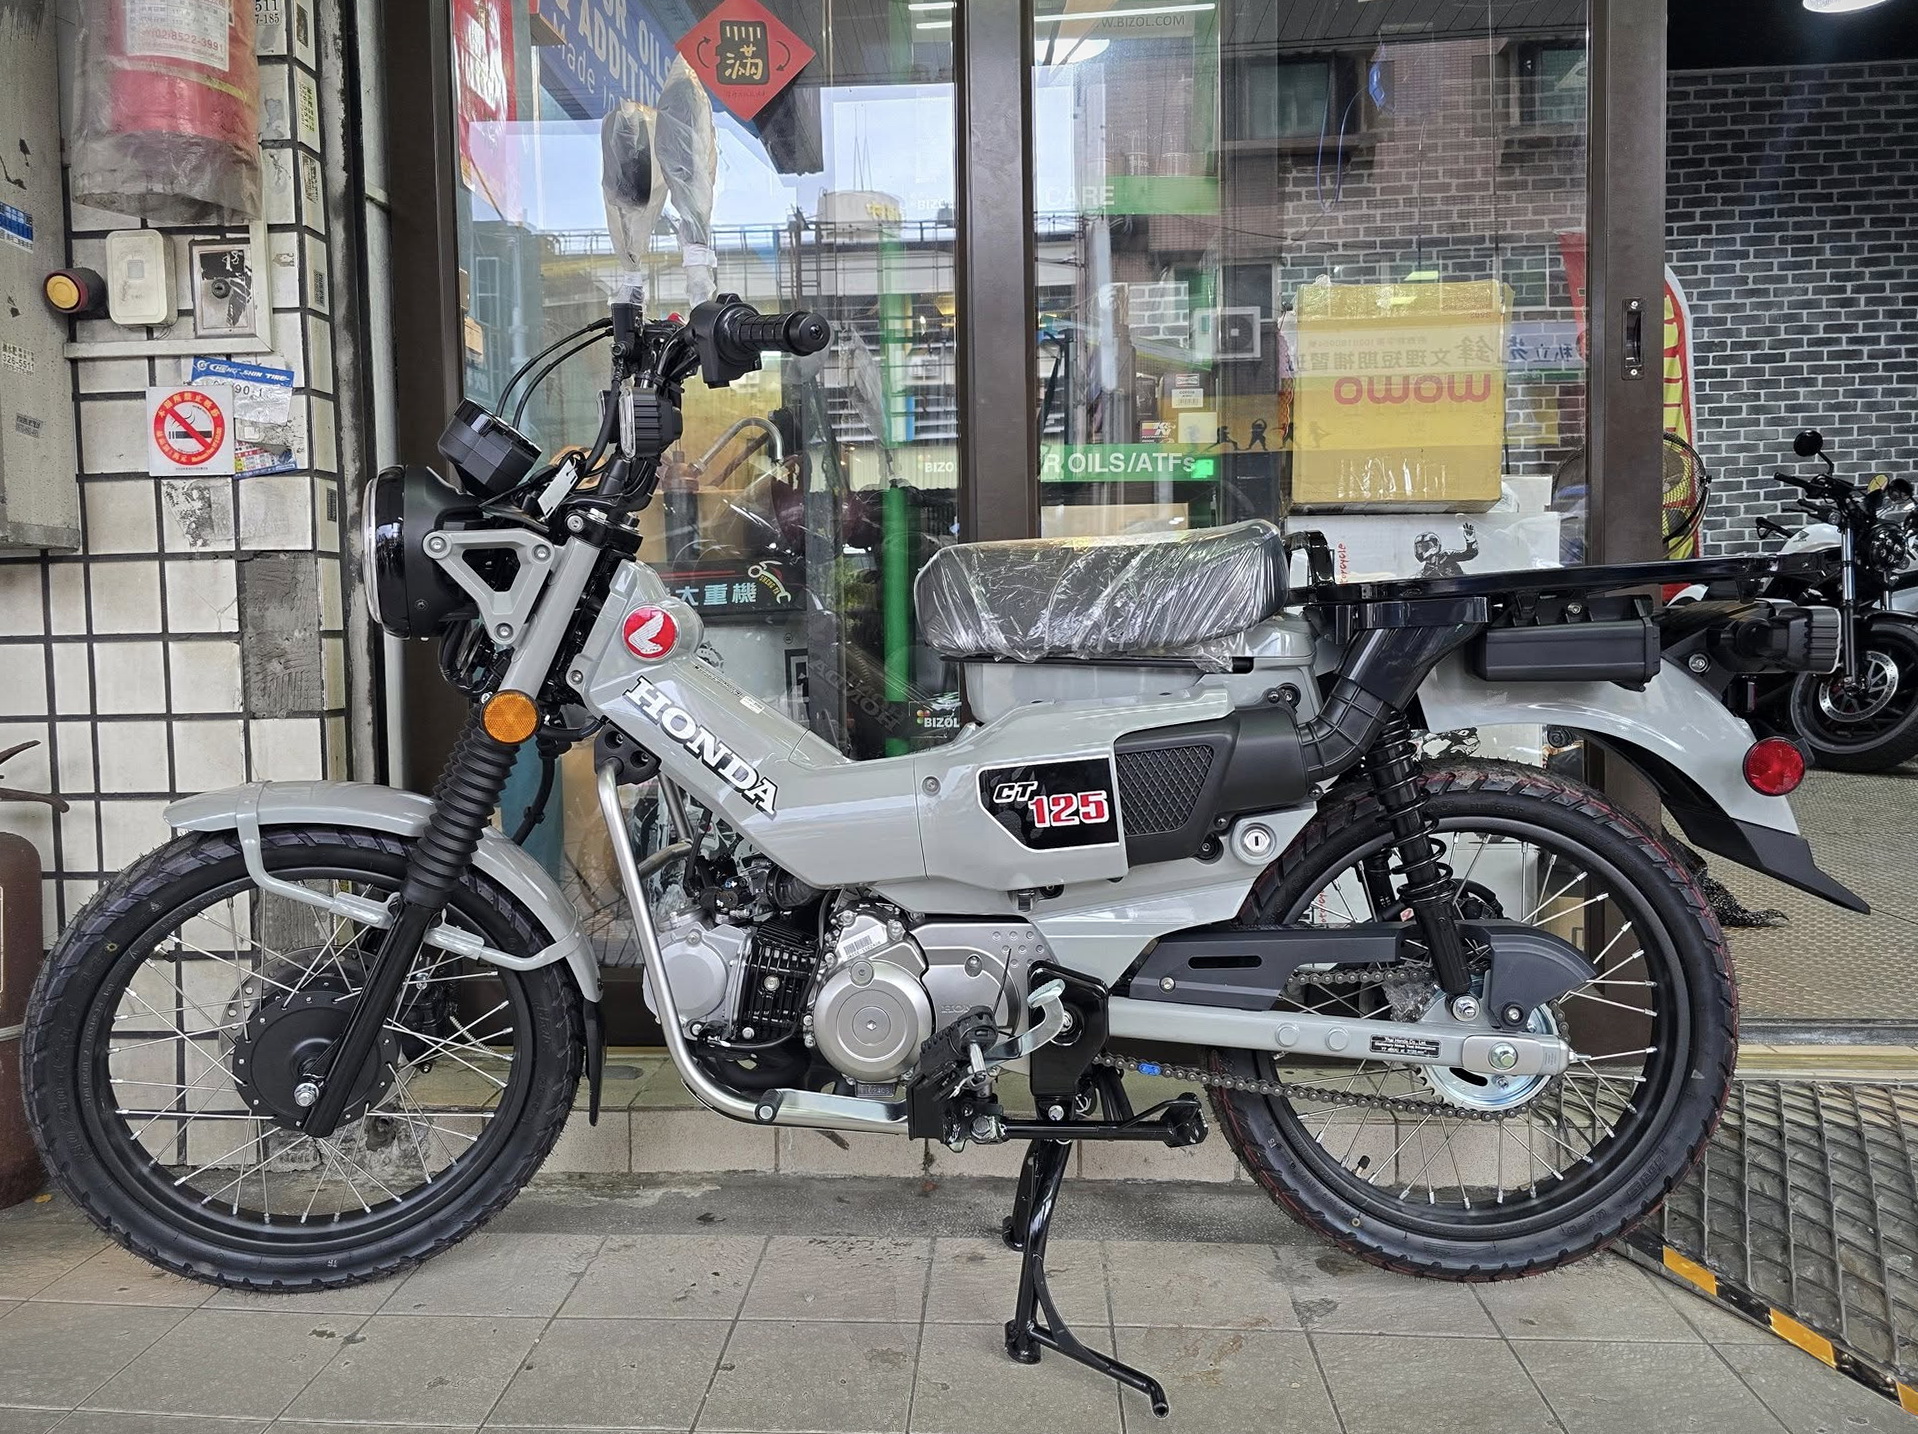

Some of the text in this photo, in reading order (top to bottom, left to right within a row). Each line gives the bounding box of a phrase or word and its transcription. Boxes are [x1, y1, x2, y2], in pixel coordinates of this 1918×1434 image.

[239, 368, 263, 377] SHIN
[924, 717, 960, 728] BIZOL
[622, 675, 777, 820] HONDA
[993, 781, 1038, 803] CT
[1028, 790, 1110, 828] 125
